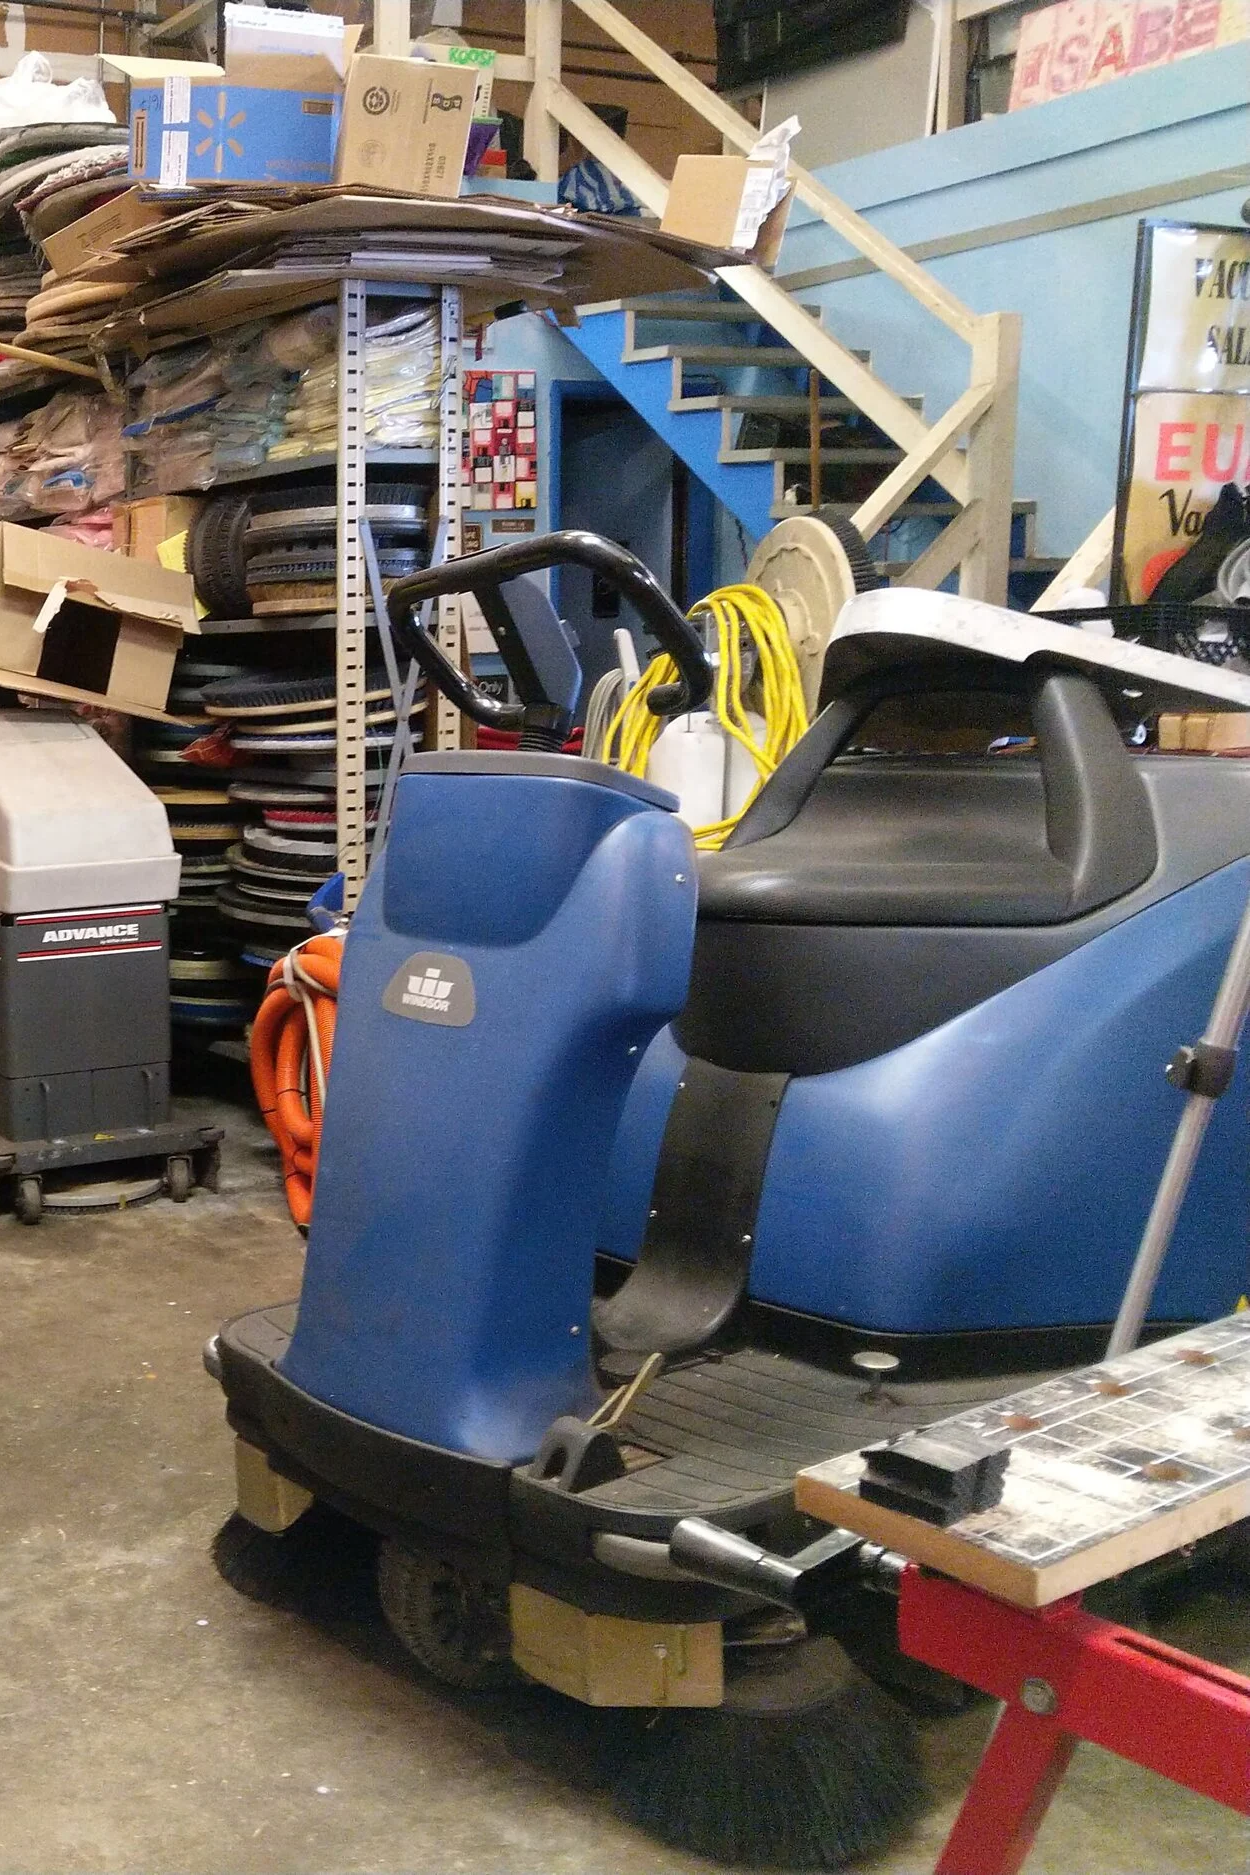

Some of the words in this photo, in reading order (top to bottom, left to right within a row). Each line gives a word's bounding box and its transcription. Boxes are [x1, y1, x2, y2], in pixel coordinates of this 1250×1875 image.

[1207, 324, 1250, 365] SAL
[1154, 421, 1250, 483] EU
[41, 923, 139, 943] ADVANCE
[401, 993, 451, 1012] WINDSOR
